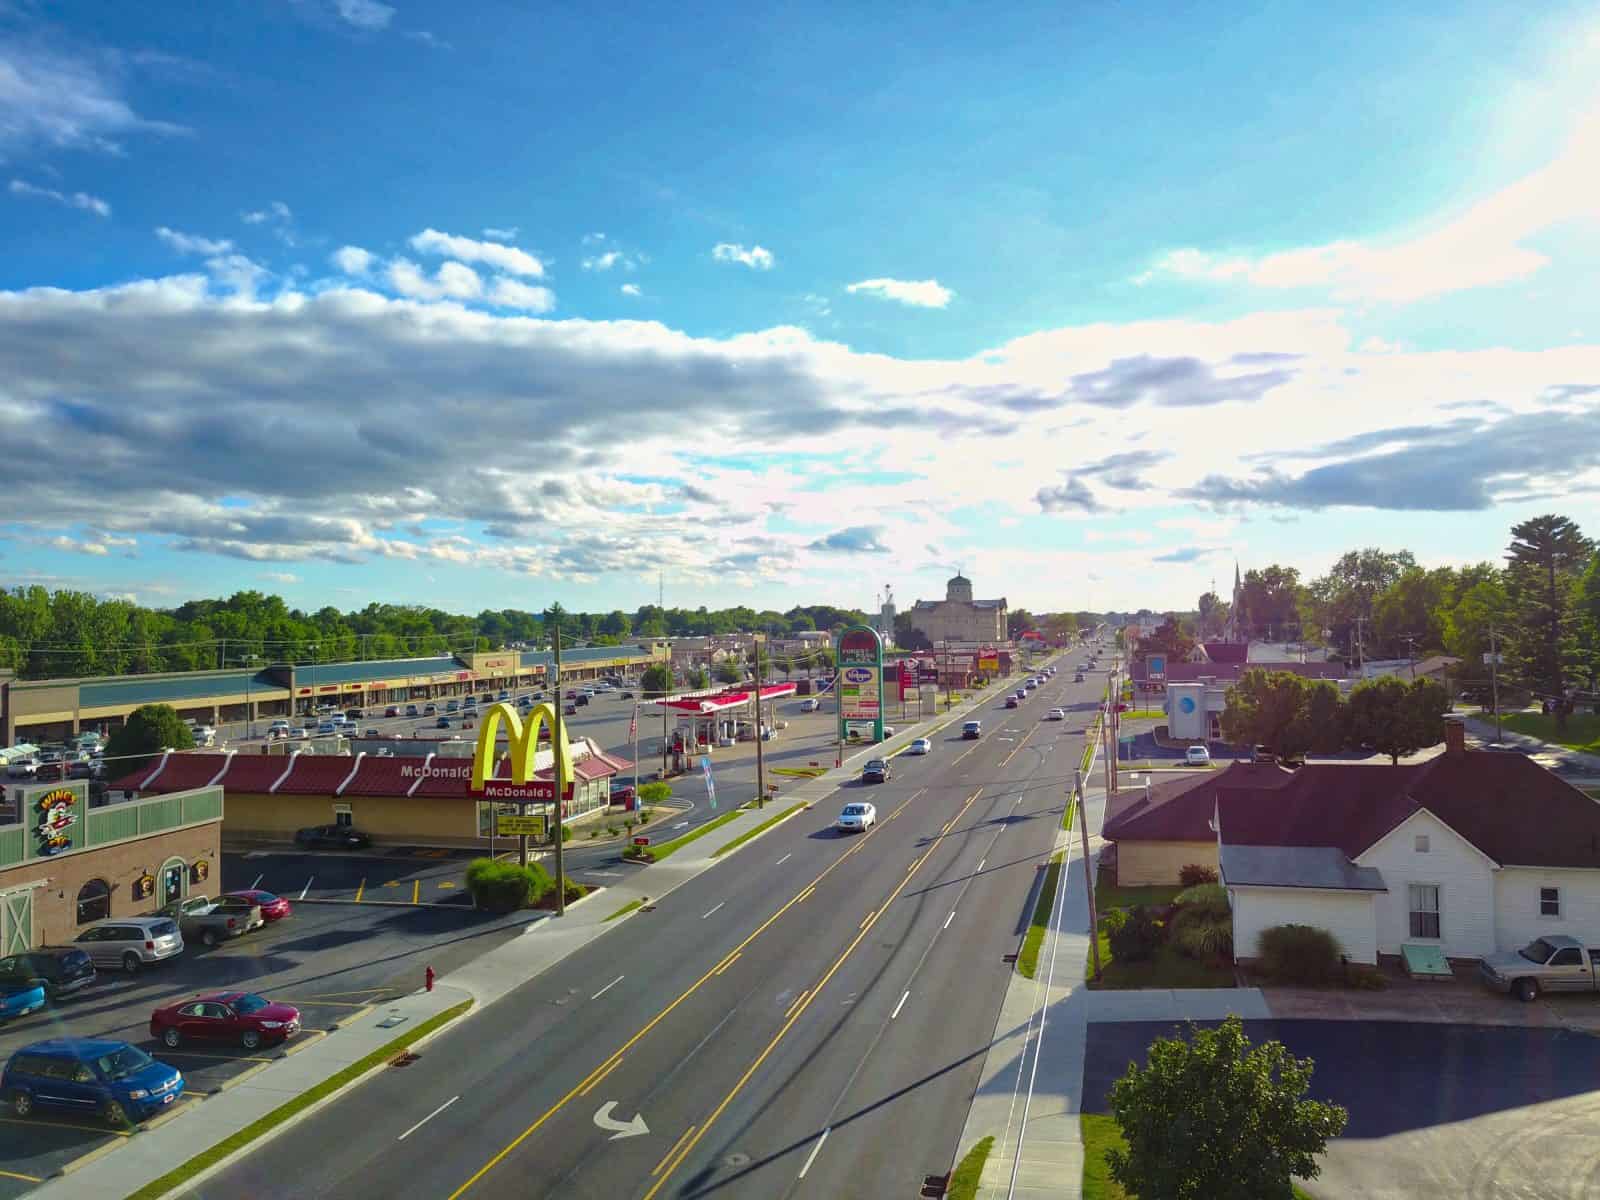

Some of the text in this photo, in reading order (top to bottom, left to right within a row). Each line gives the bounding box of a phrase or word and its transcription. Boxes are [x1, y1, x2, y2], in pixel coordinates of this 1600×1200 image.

[400, 765, 474, 778] McDonald'
[485, 786, 553, 798] McDonald's
[40, 789, 77, 811] WINGS
